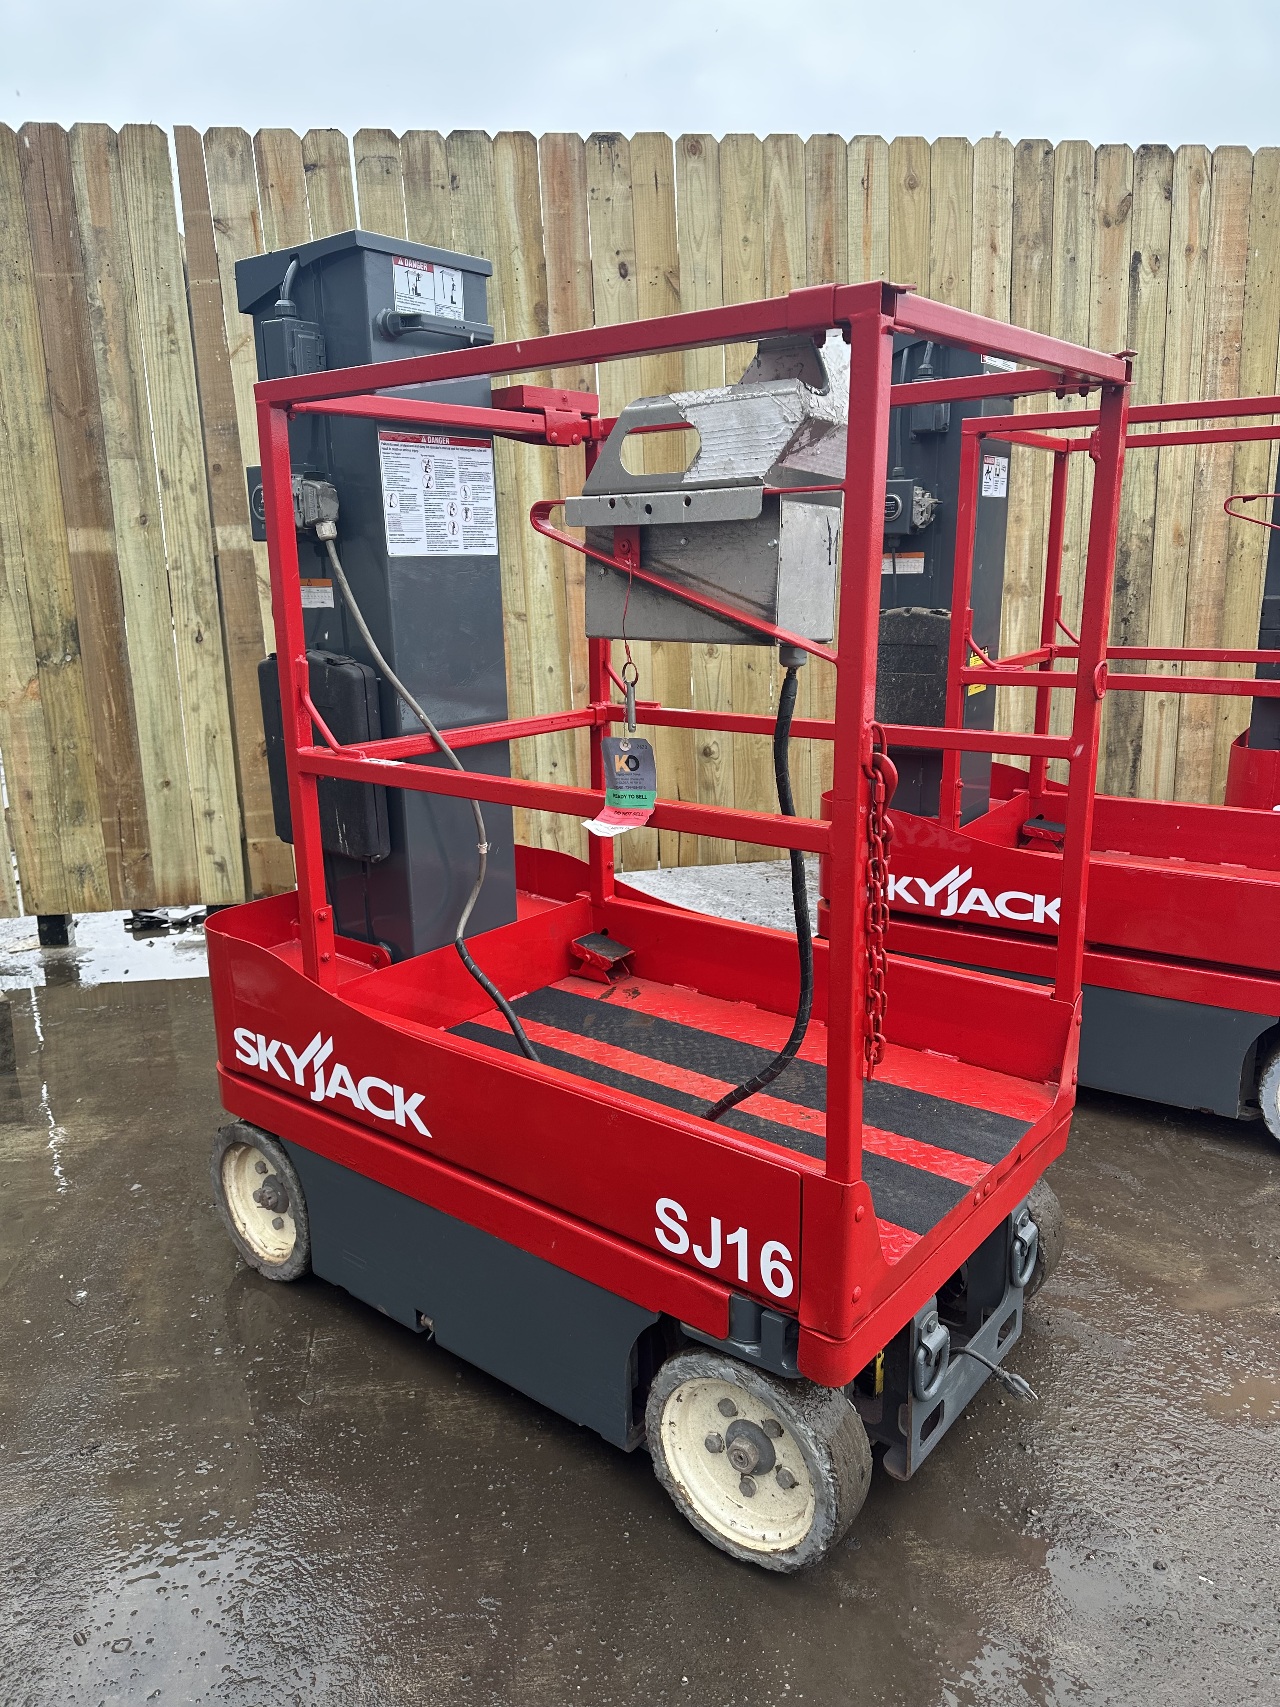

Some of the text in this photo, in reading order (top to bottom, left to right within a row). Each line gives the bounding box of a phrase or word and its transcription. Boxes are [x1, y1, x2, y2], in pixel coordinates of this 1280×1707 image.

[404, 259, 428, 271] DANGER
[427, 436, 450, 445] DANGER
[867, 865, 1061, 925] KYJACK
[233, 1027, 433, 1139] SKYJACK
[654, 1197, 794, 1298] SJ16
